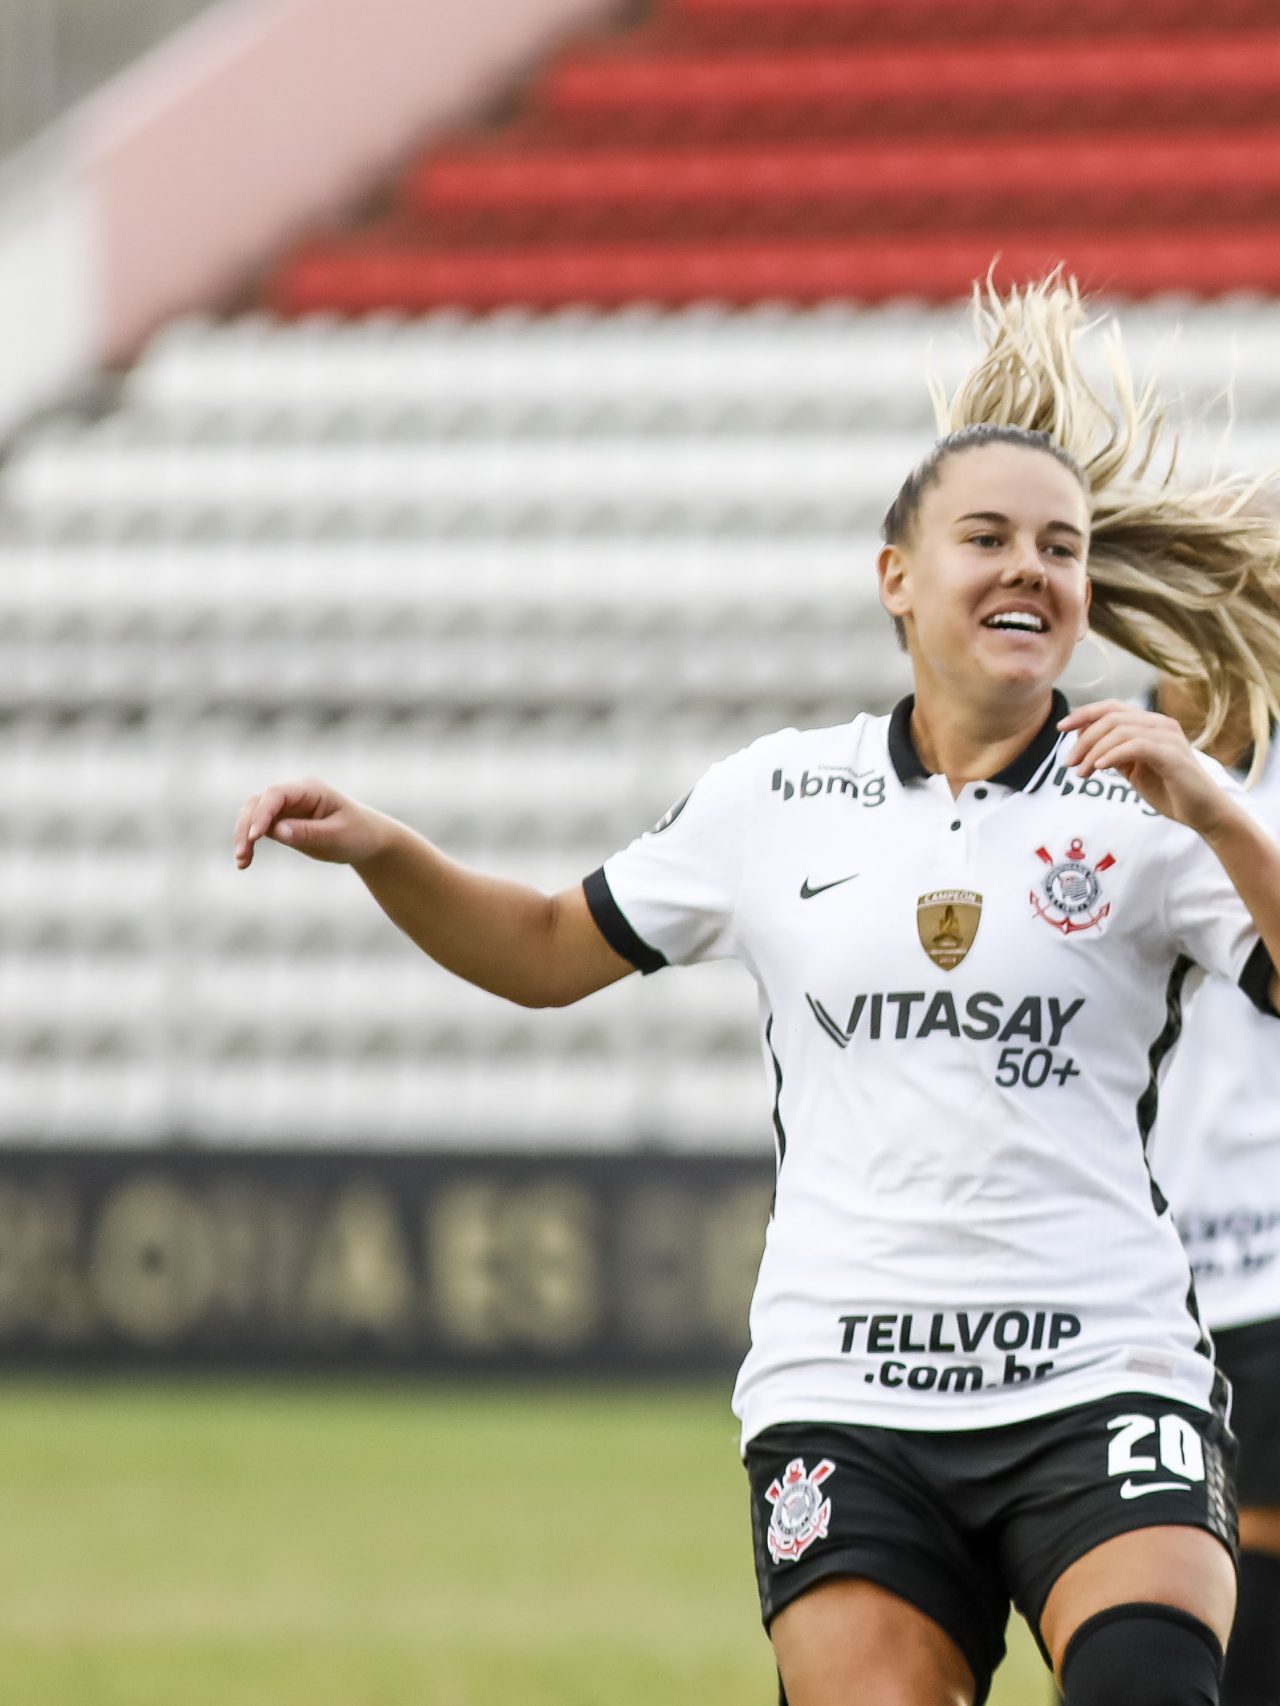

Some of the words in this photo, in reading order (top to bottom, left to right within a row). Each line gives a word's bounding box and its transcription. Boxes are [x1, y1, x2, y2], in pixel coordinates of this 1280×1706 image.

[799, 769, 886, 808] bmg
[1079, 775, 1161, 816] bm
[805, 990, 1086, 1048] VITASAY
[995, 1047, 1081, 1088] 50+
[838, 1310, 1082, 1354] TELLVOIP
[864, 1354, 1055, 1393] .com.br
[1107, 1413, 1206, 1482] 20
